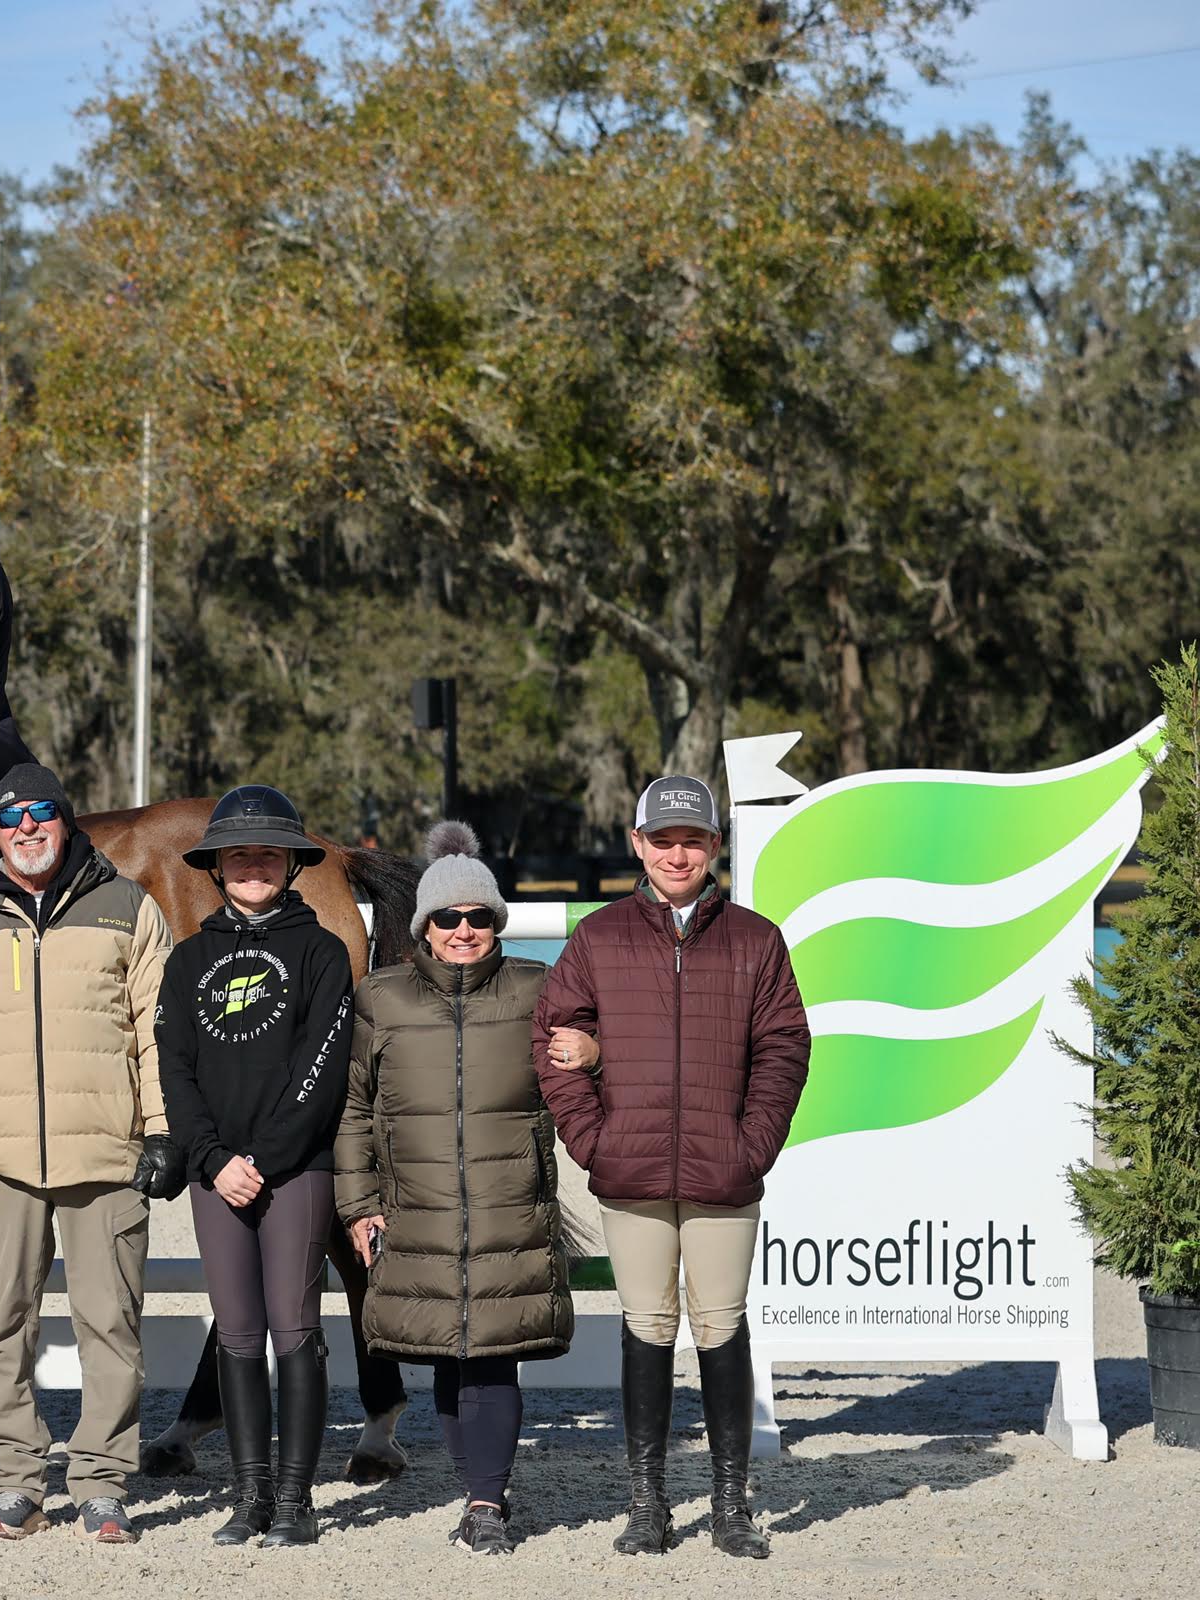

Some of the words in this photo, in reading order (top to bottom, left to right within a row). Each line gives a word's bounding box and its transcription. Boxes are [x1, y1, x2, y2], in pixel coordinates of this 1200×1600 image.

[659, 792, 675, 802] Full
[677, 792, 701, 803] Circle
[97, 917, 132, 928] SPYDER
[197, 952, 234, 989] EXCELLENCE
[235, 950, 244, 959] IN
[246, 949, 290, 982] INTERNATIONAL
[198, 1009, 228, 1041] HORSE
[232, 1001, 287, 1042] SHIPPING
[296, 995, 351, 1103] CHALLENGE
[762, 1219, 1036, 1301] horseflight
[1042, 1275, 1070, 1288] .com
[762, 1305, 840, 1325] Excellence
[845, 1305, 858, 1324] in
[863, 1304, 952, 1325] International
[957, 1305, 1001, 1325] Horse
[1006, 1304, 1069, 1329] Shipping
